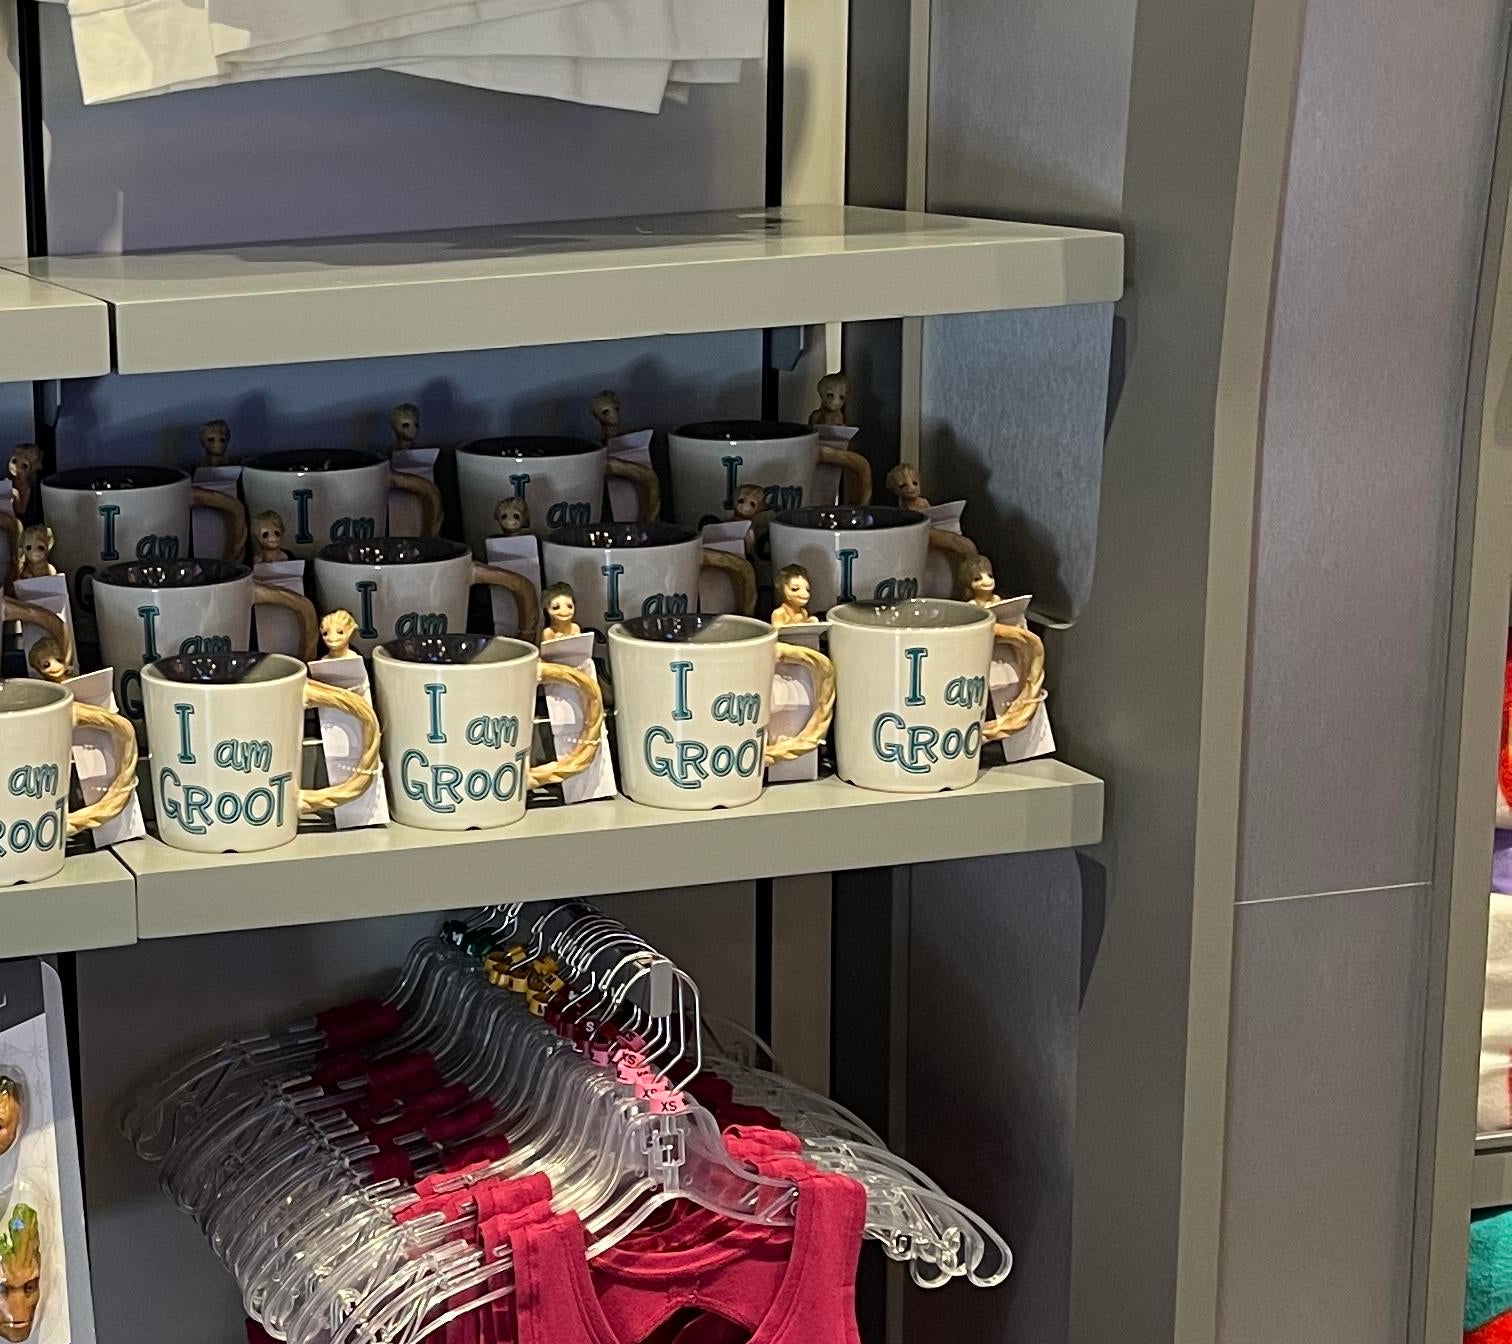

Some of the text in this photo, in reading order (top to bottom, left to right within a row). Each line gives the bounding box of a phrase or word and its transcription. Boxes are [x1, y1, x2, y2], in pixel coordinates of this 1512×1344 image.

[721, 456, 744, 510] I
[99, 505, 179, 560] I am
[293, 488, 375, 544] I am
[547, 500, 591, 527] am
[601, 565, 625, 621] I
[836, 548, 859, 602] I
[138, 606, 162, 658] I
[356, 581, 448, 639] I am
[670, 661, 761, 726] I am
[905, 647, 985, 708] I am
[174, 703, 273, 773] I am
[424, 683, 518, 749] I am
[872, 712, 984, 774] GROO
[8, 762, 59, 799] am
[159, 766, 293, 835] GROOT
[401, 748, 531, 814] GROOT
[661, 1100, 677, 1111] XS
